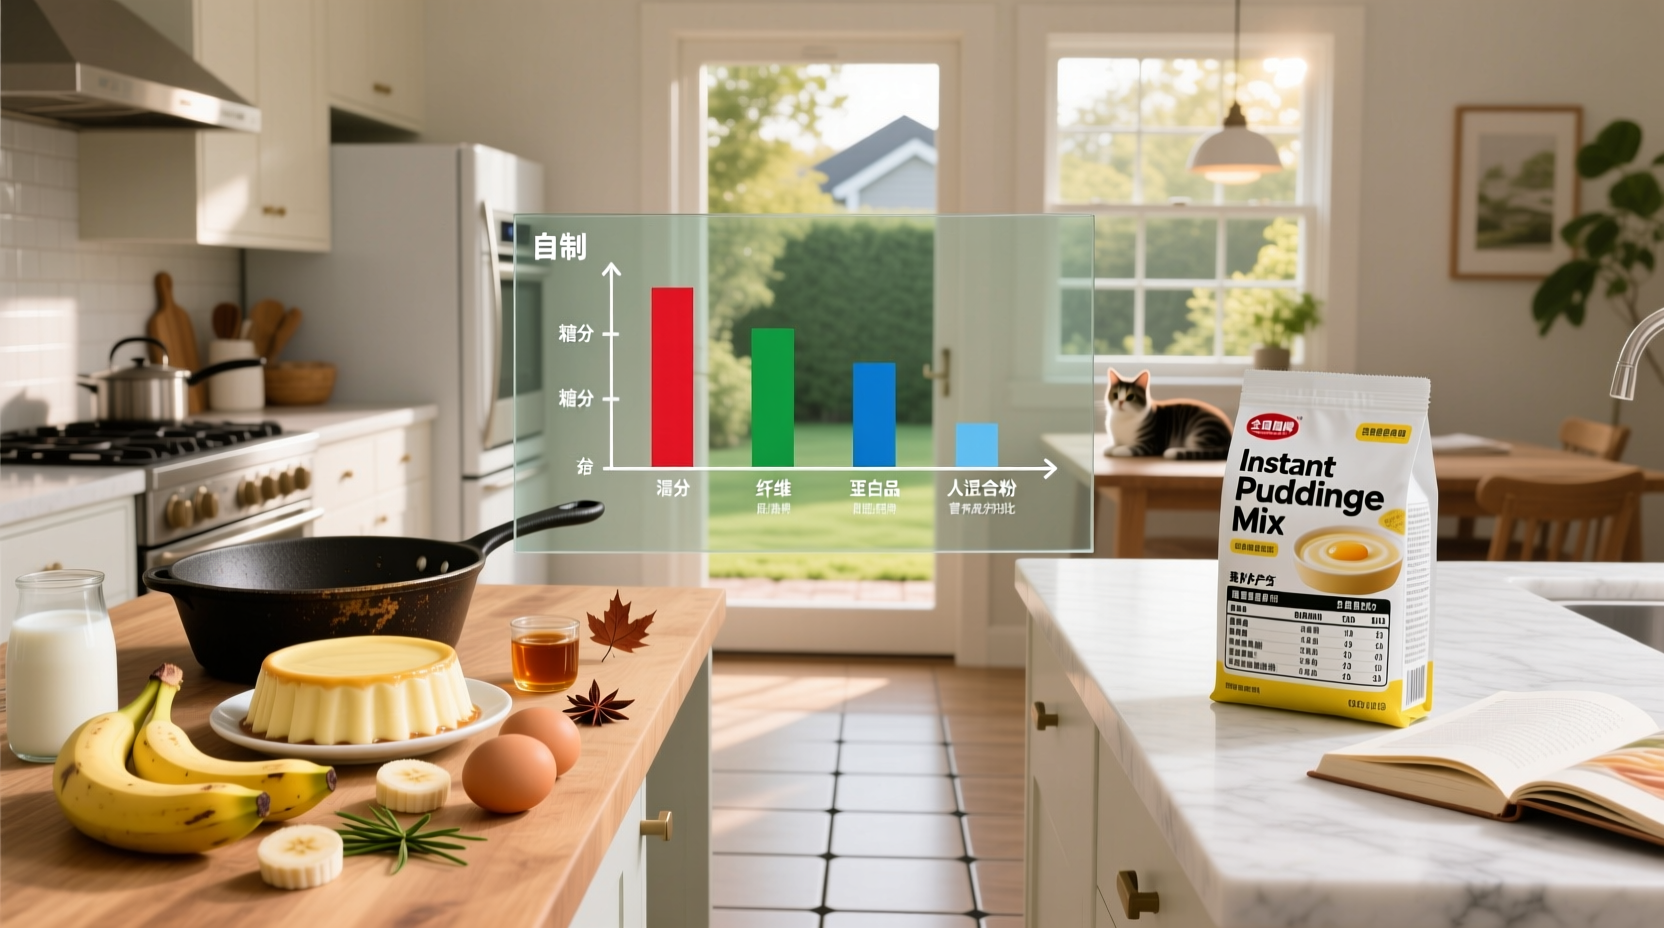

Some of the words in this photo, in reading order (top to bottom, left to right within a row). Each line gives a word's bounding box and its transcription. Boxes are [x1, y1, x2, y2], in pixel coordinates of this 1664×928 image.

[534, 232, 587, 261] 自制
[1239, 448, 1336, 478] Instant
[755, 478, 792, 498] 纤维
[1235, 476, 1385, 517] Puddinge
[1232, 505, 1286, 536] Mix
